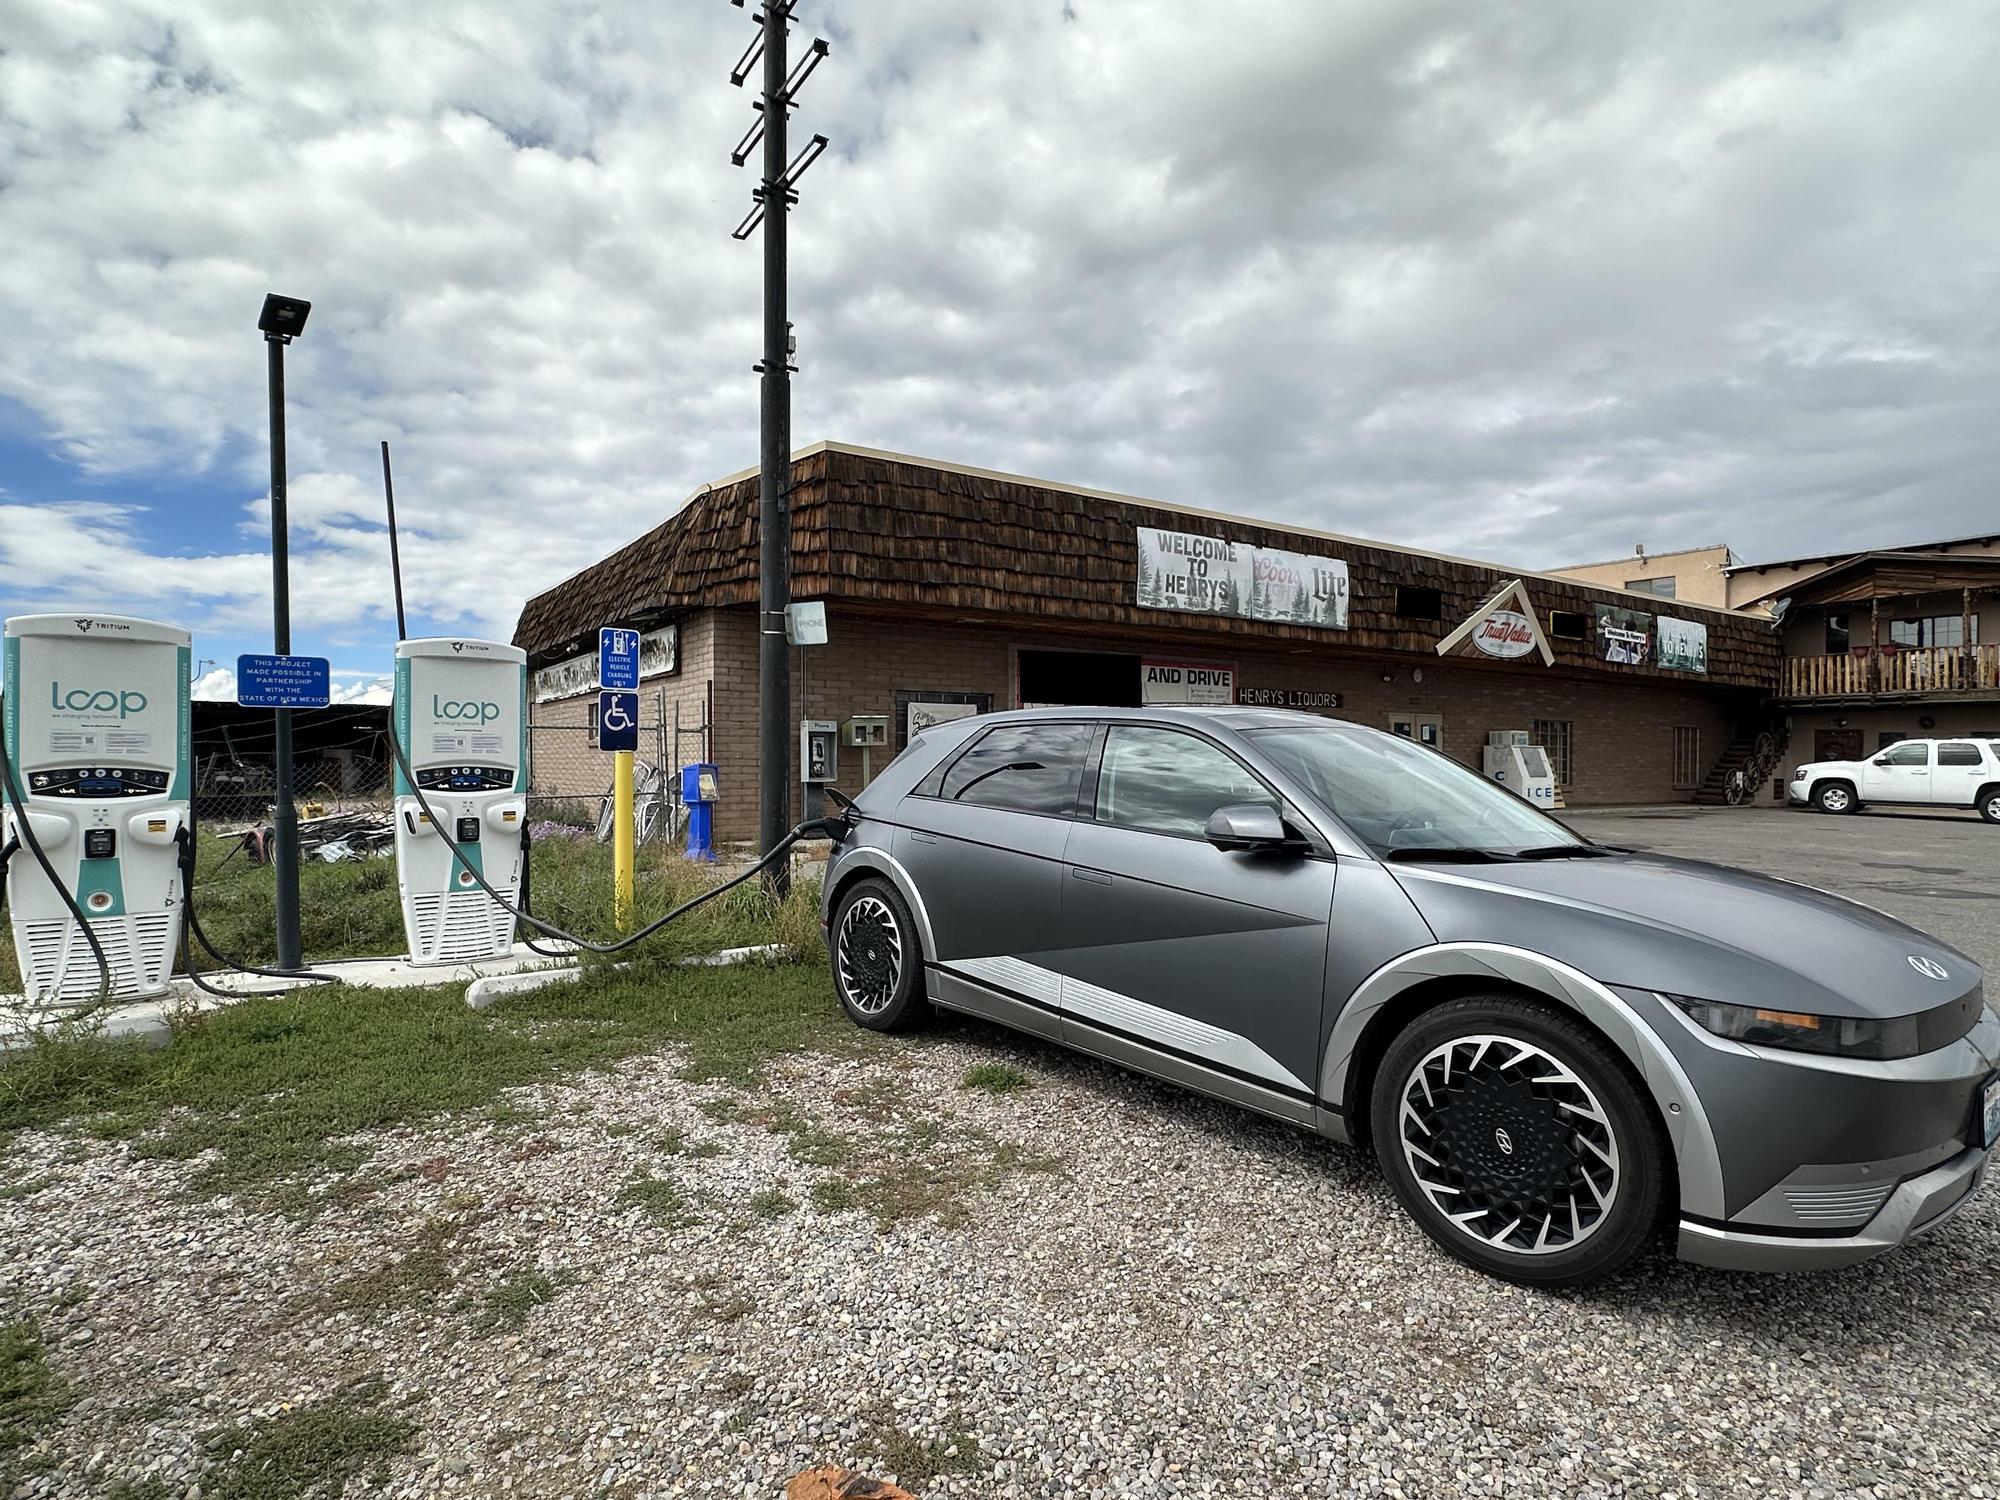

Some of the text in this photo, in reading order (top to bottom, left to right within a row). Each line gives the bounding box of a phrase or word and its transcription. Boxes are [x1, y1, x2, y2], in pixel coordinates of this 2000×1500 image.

[1157, 533, 1238, 563] WELCOME
[1187, 557, 1208, 578] TO
[1254, 557, 1300, 586] Coors
[1165, 574, 1229, 600] HENRYS
[1311, 567, 1346, 602] Lite
[95, 622, 130, 631] TRITIUM
[800, 618, 824, 628] PHONE
[1663, 640, 1673, 654] TO
[272, 669, 311, 677] POSSIBLE
[275, 660, 311, 668] PROJECT
[1147, 667, 1230, 687] AND DRIVE
[52, 681, 148, 719] loop
[1239, 688, 1338, 707] HENRYS LIQUORS
[433, 694, 500, 726] loop
[1527, 787, 1552, 798] ICE
